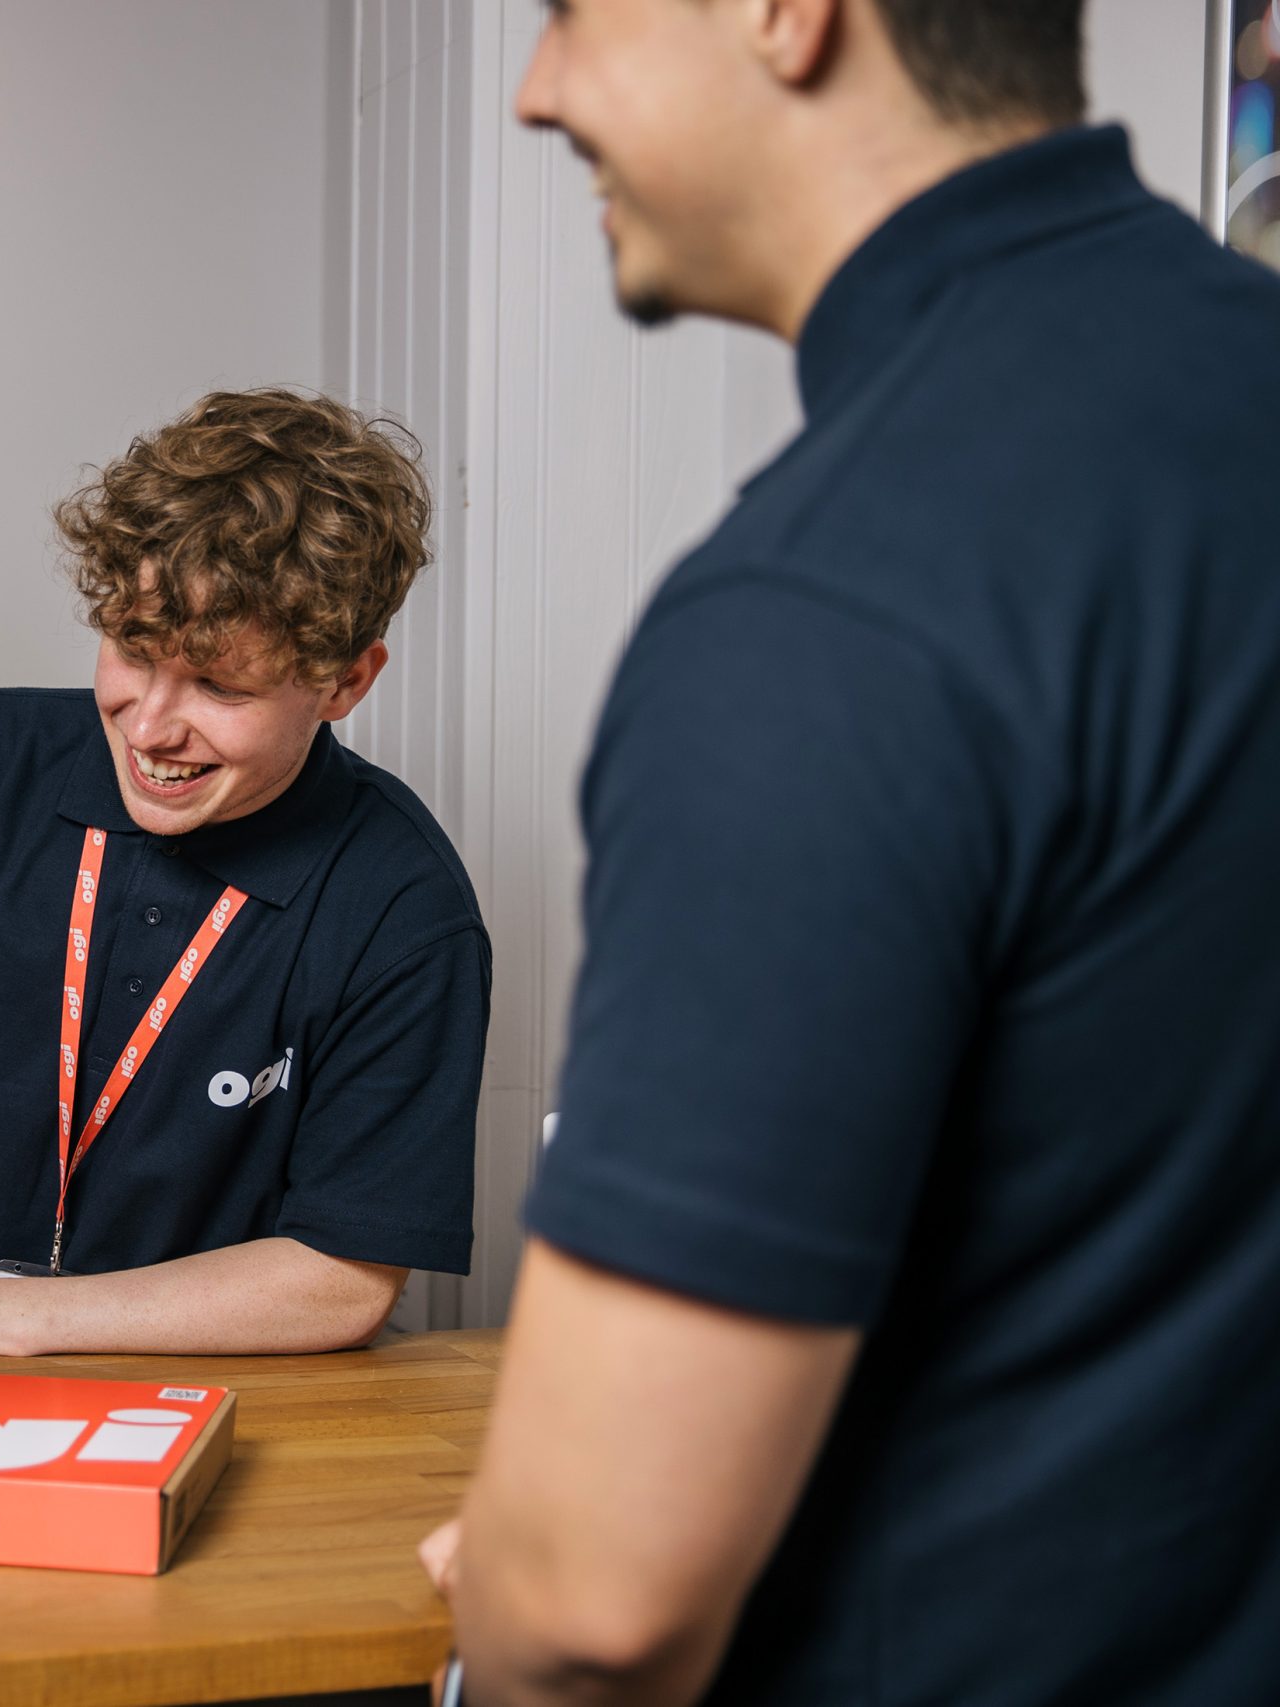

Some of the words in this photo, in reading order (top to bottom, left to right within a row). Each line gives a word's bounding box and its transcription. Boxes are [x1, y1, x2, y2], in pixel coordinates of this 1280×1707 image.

[79, 869, 95, 904] ogi
[211, 898, 231, 935] ogi
[69, 927, 87, 962] ogi
[179, 947, 198, 985] ogi
[64, 985, 81, 1021] ogi
[149, 997, 167, 1033] ogi
[60, 1043, 76, 1079] ogi
[121, 1045, 138, 1080] ogi
[207, 1047, 294, 1109] ogi
[94, 1095, 110, 1126] ogi
